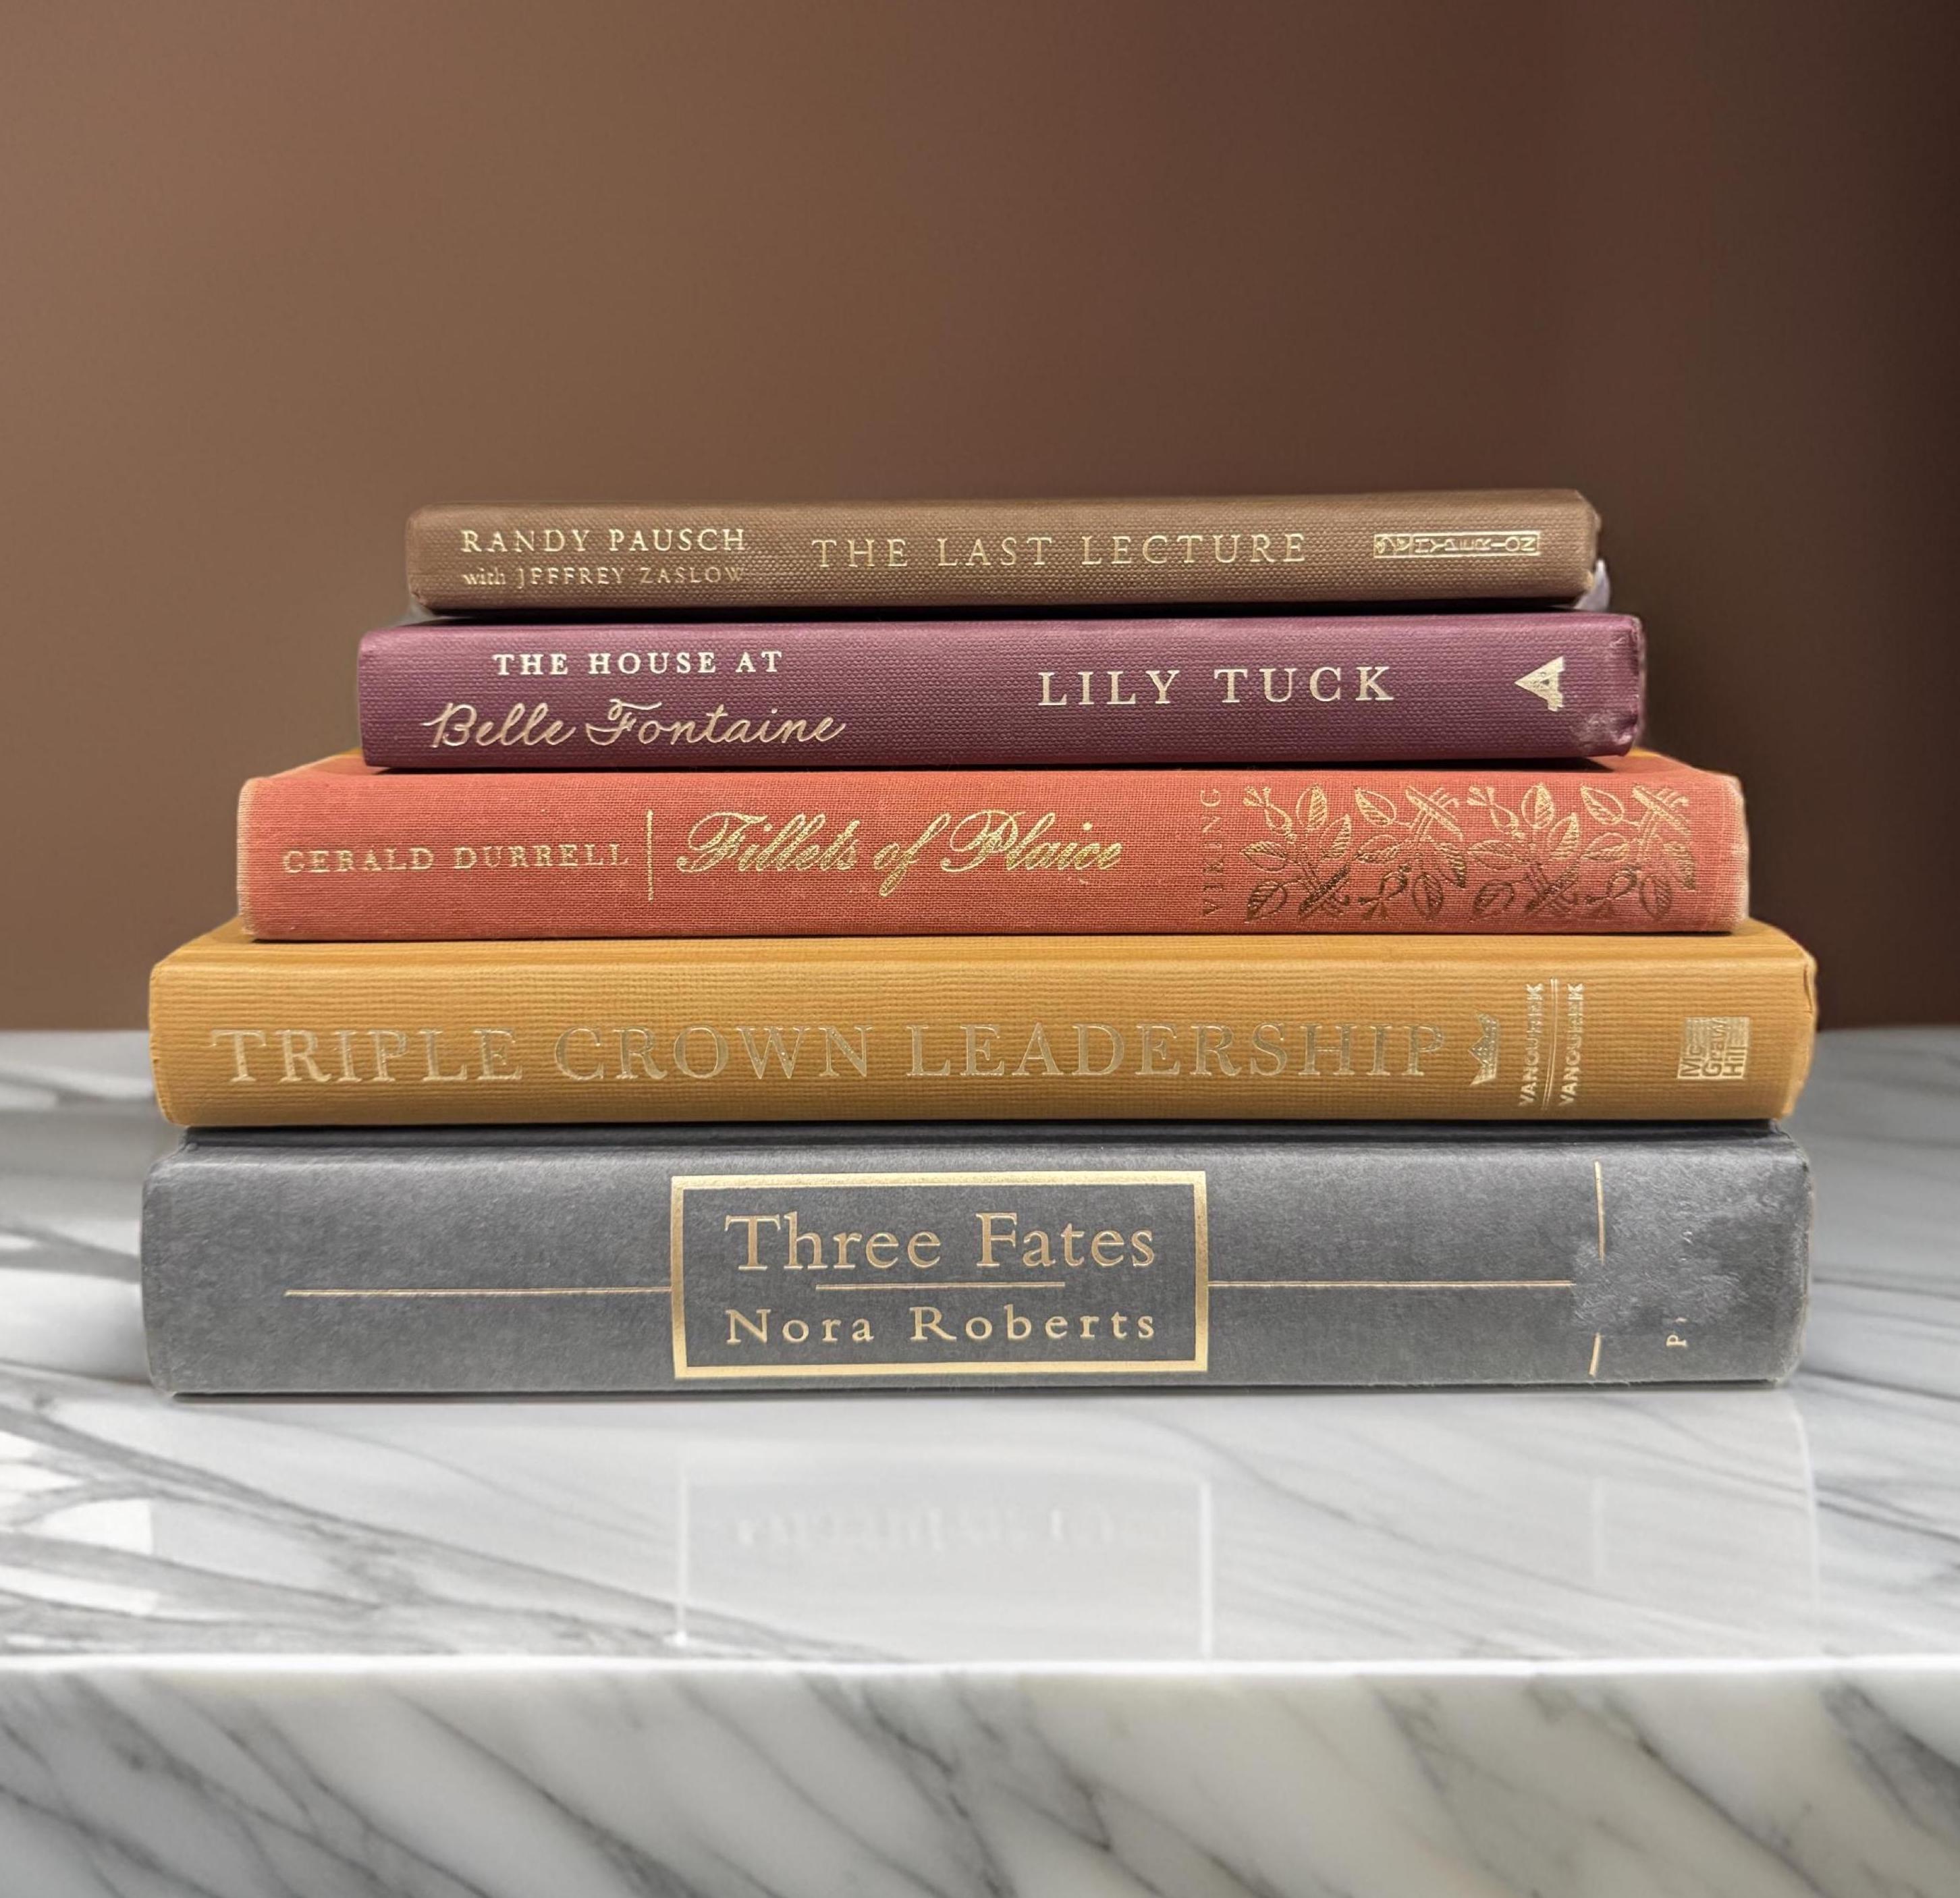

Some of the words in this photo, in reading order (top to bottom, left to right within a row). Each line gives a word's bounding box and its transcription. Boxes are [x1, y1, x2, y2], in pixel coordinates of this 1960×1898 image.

[460, 528, 590, 552] RANDY
[608, 528, 747, 551] PAUSCH
[812, 538, 908, 570] THE
[938, 535, 1054, 568] LAST
[1081, 533, 1307, 566] LECTURE
[462, 567, 506, 585] with
[640, 566, 744, 585] ZASLOW
[492, 653, 568, 676] THE
[589, 652, 716, 675] HOUSE
[735, 650, 782, 672] AT
[1039, 670, 1180, 707] LILY
[1214, 666, 1395, 703] TUCK
[420, 702, 576, 749] Belle
[585, 698, 847, 746] Fontaine
[282, 847, 434, 873] GERALD
[454, 844, 629, 871] DURRELL
[676, 811, 861, 873] Fillets
[873, 813, 951, 898] of
[939, 809, 1123, 872] Plaice
[1199, 786, 1223, 919] VIKING
[211, 1028, 524, 1083] TRIPLE
[555, 1024, 874, 1080] CROWN
[905, 1022, 1447, 1077] LEADERSHIP
[1722, 1045, 1747, 1077] Hill
[724, 1210, 942, 1272] Three
[975, 1212, 1156, 1268] Fates
[725, 1308, 875, 1345] Nora
[909, 1305, 1155, 1341] Roberts
